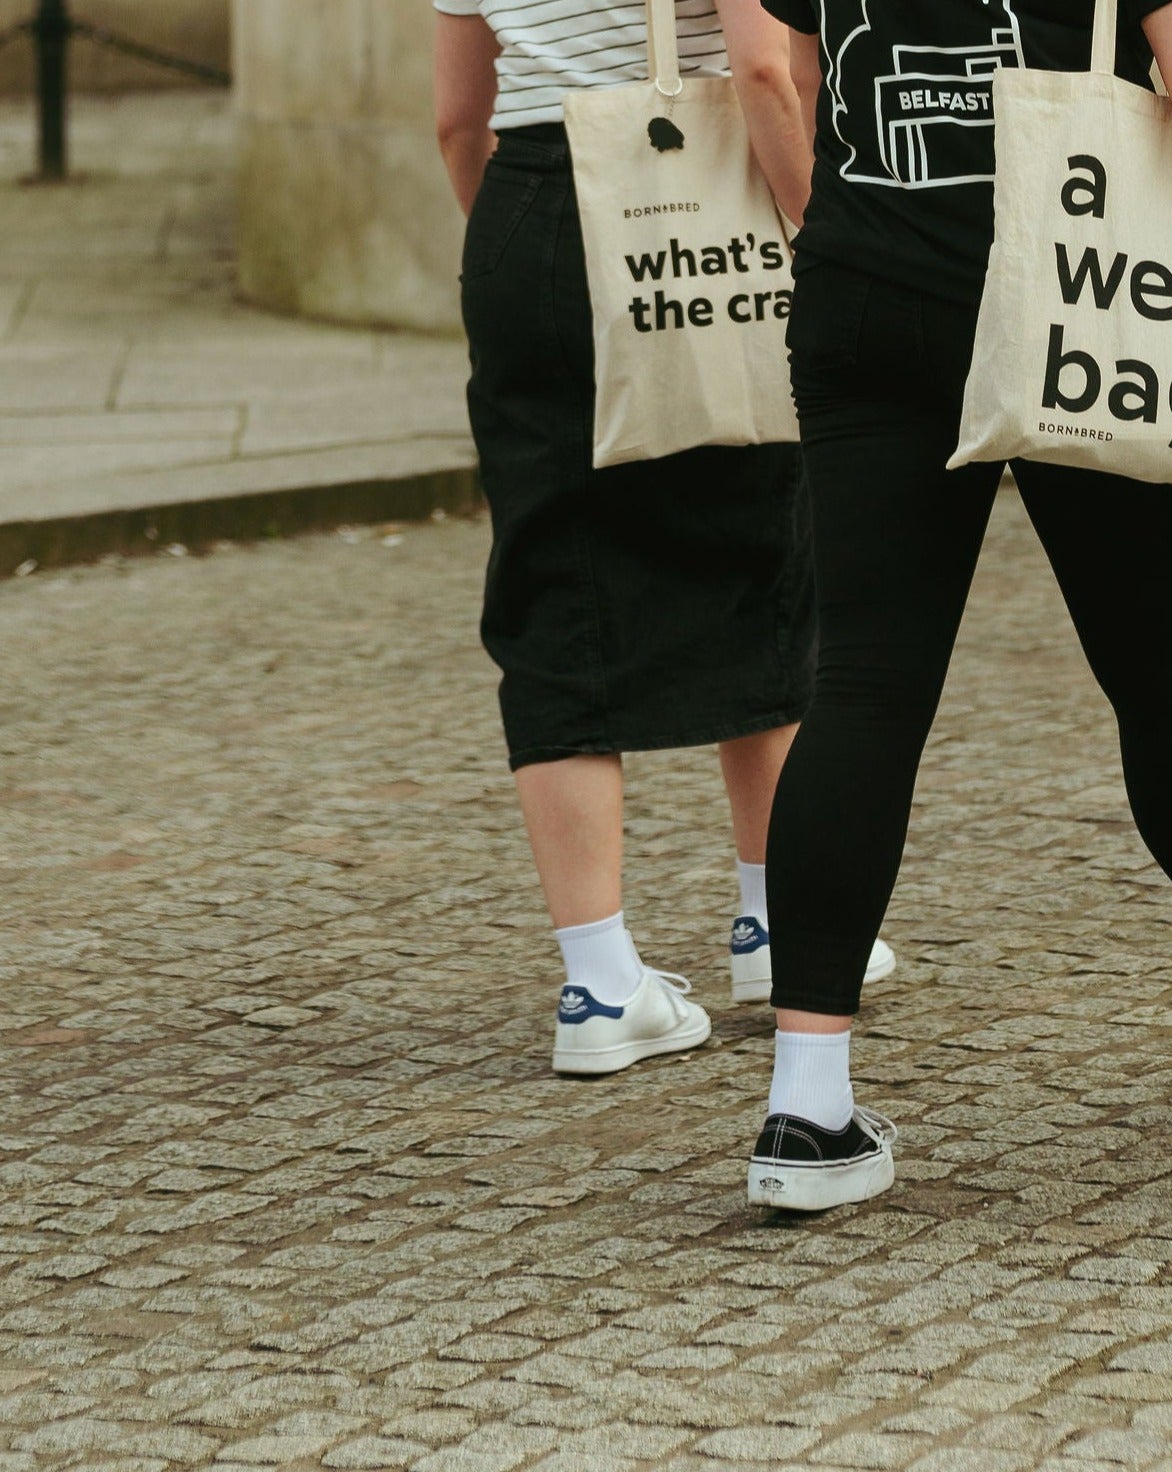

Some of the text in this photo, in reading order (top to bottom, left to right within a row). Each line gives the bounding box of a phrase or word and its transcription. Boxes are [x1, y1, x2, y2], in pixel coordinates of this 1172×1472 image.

[899, 89, 990, 111] BELFAST
[1060, 154, 1107, 219] a
[624, 232, 783, 283] what's
[628, 289, 714, 333] the
